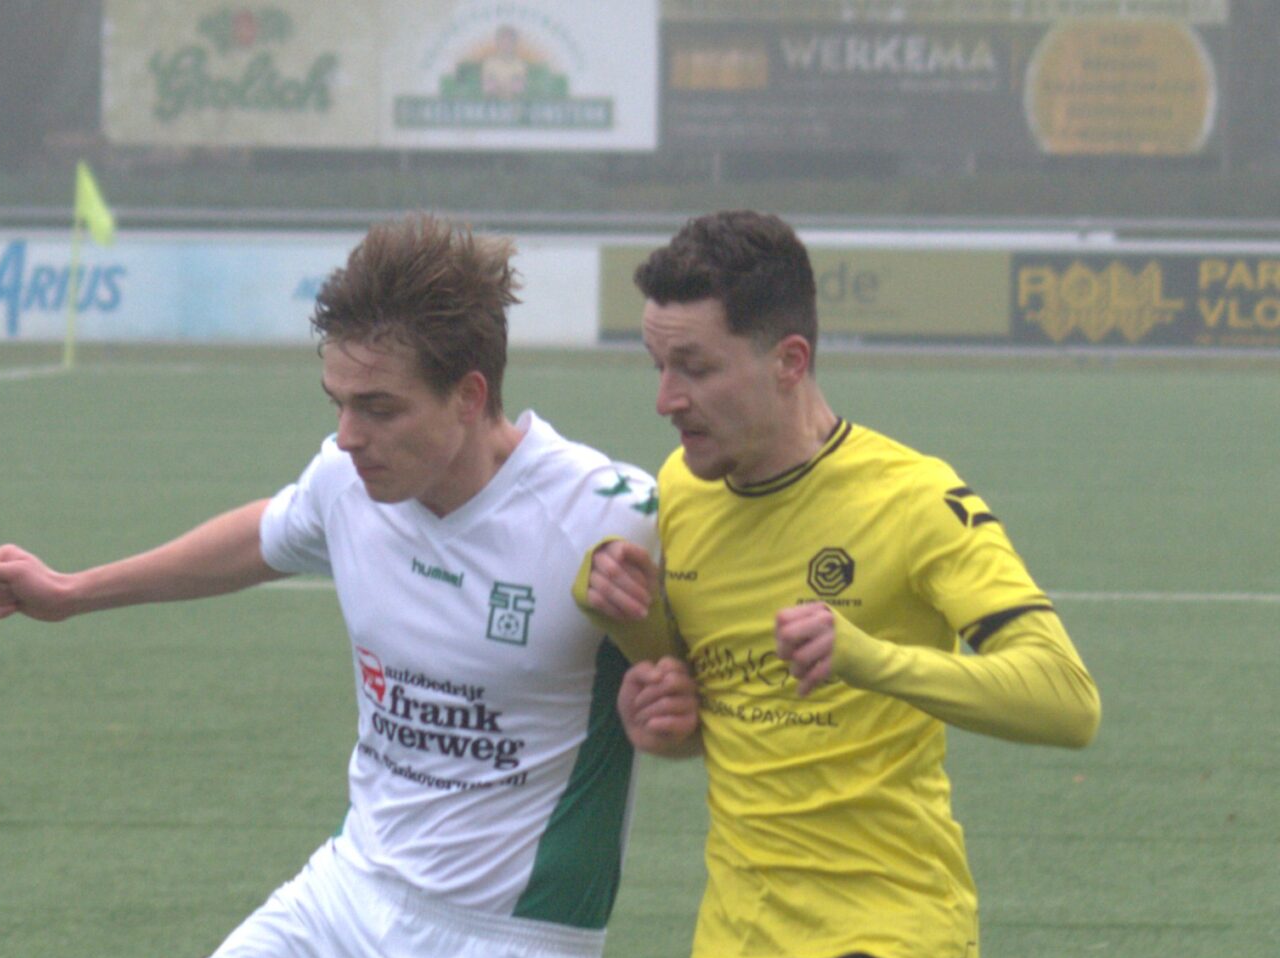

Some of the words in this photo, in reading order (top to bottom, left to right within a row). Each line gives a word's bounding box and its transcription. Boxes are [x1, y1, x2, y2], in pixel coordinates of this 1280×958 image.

[781, 35, 996, 73] WERKEMA
[411, 557, 465, 590] hummel
[384, 665, 486, 702] autobedrijf
[388, 685, 504, 733] frank
[751, 706, 839, 728] PAYROLL
[371, 711, 526, 771] overweg
